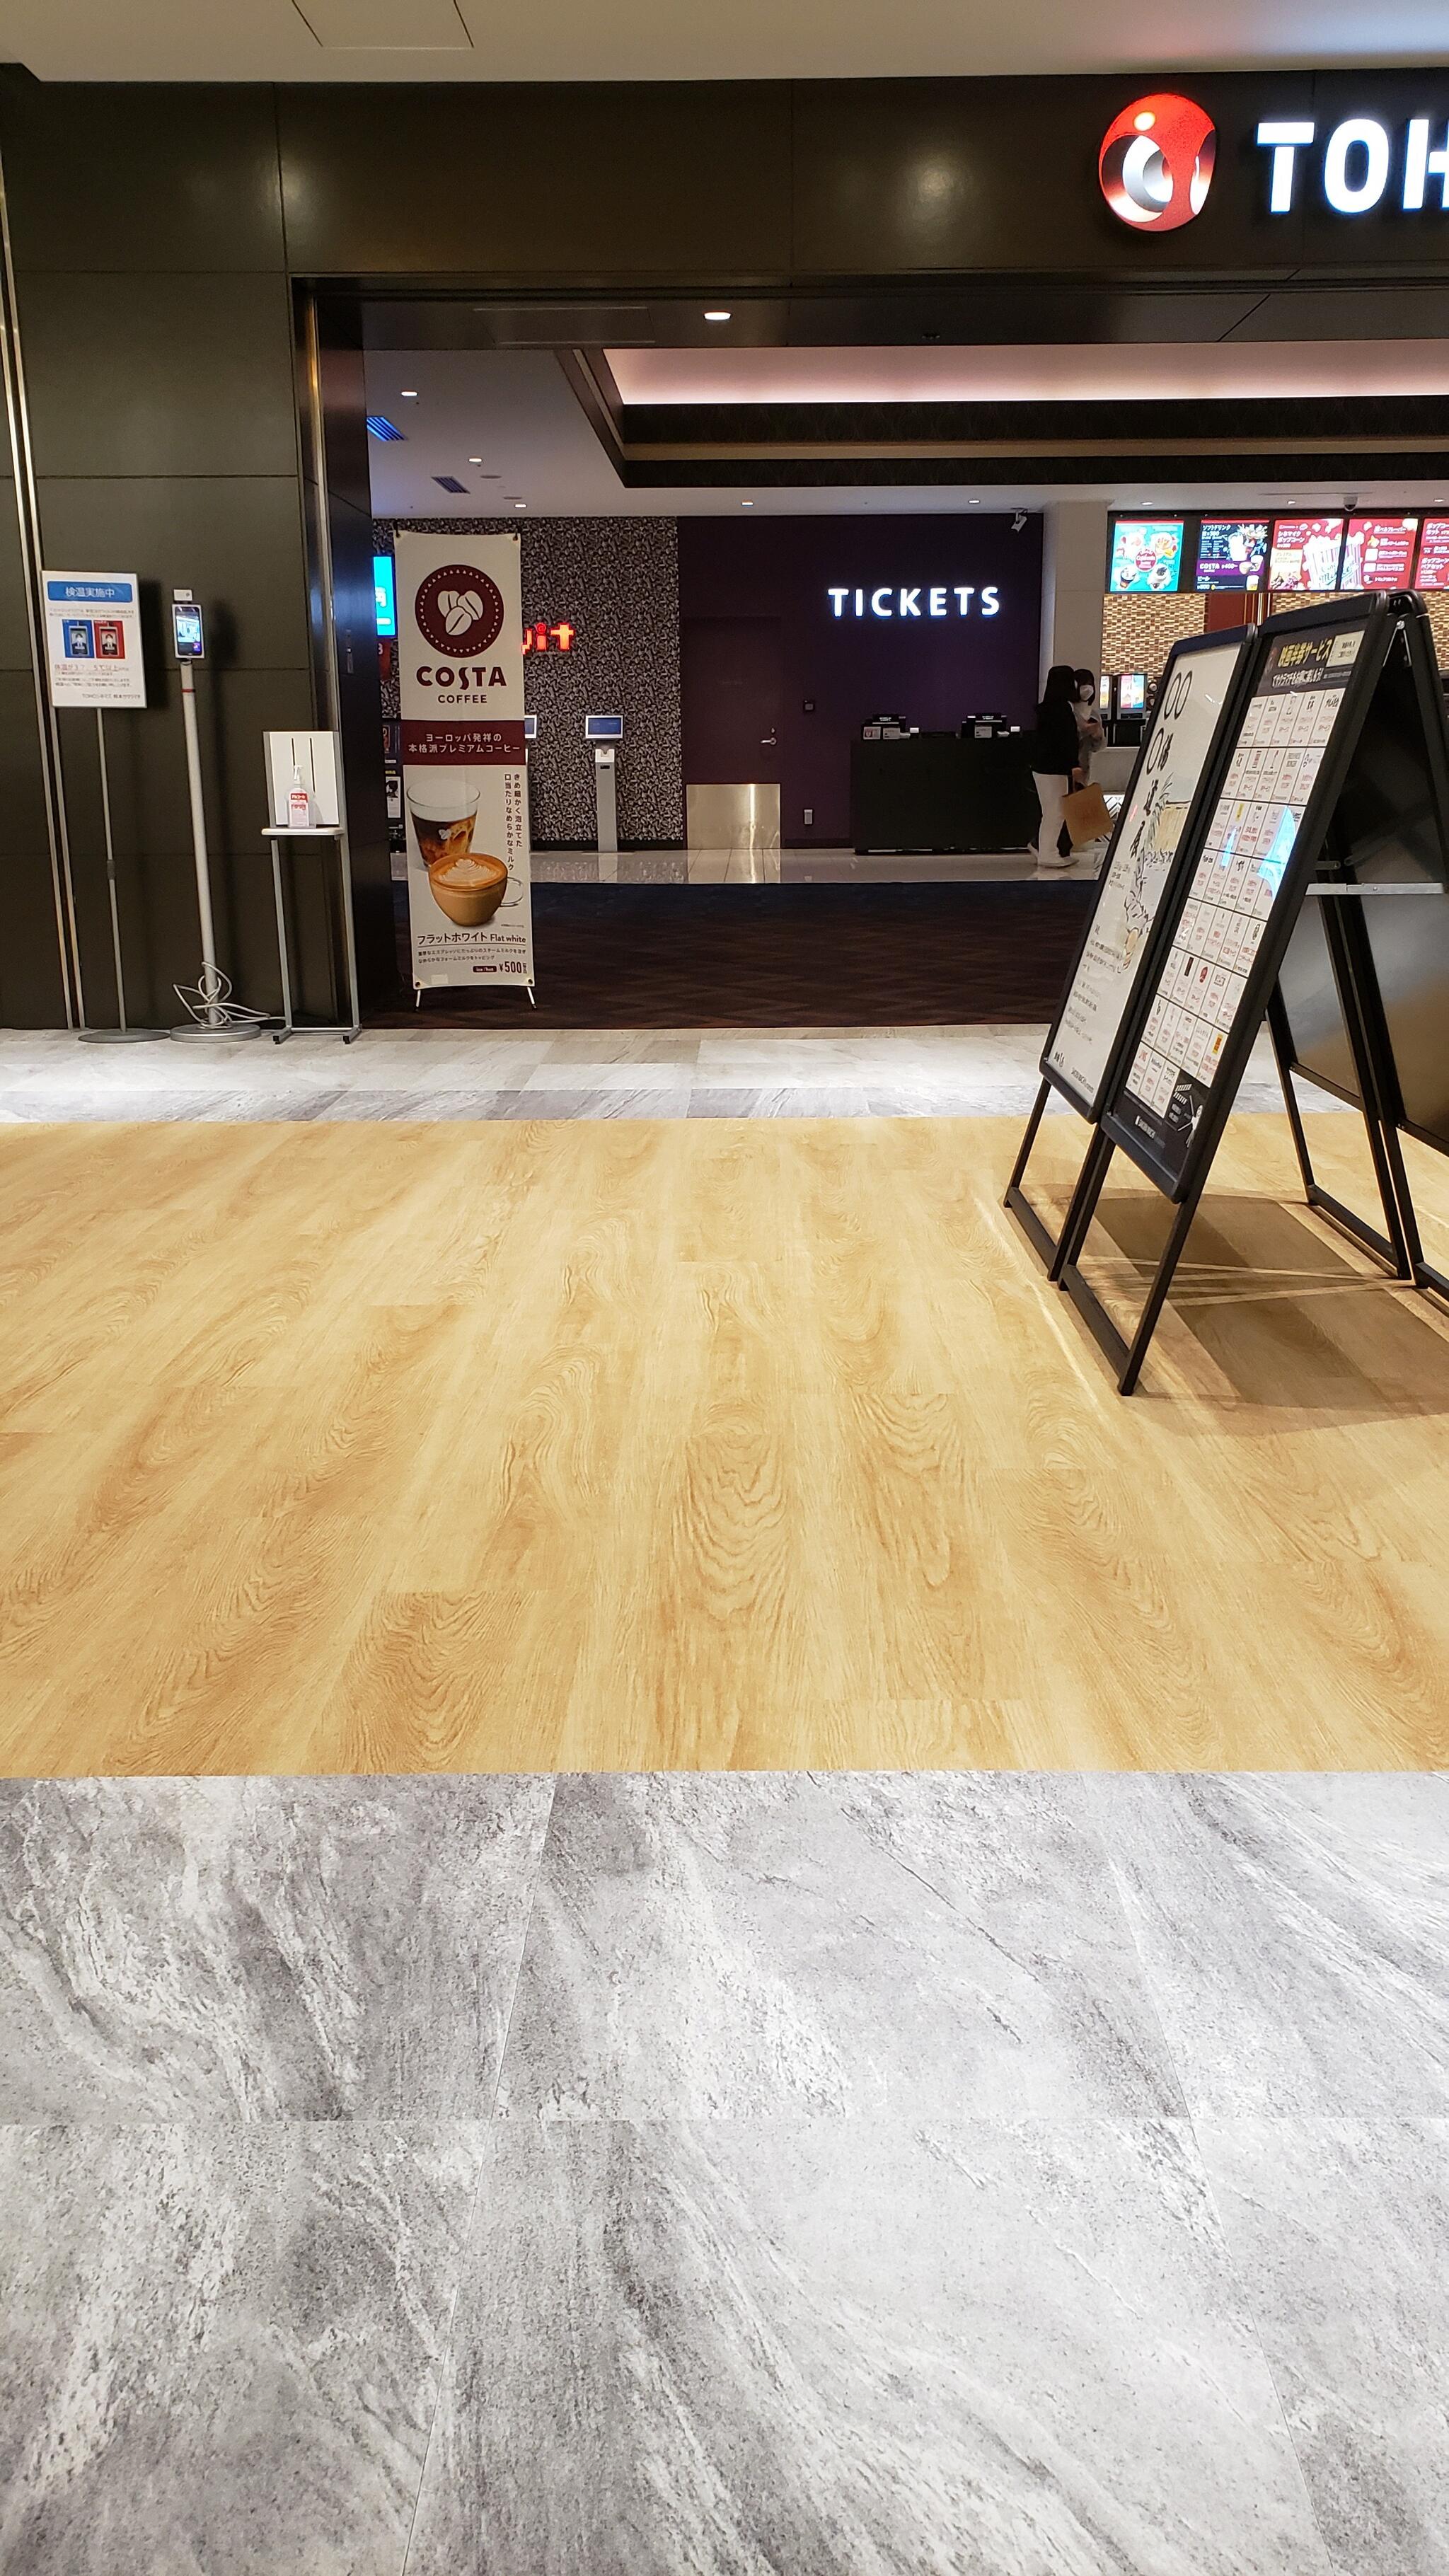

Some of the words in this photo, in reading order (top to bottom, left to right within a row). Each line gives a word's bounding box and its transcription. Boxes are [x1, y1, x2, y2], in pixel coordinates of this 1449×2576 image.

[65, 587, 115, 598] 検温実施中
[828, 587, 1000, 617] TICKETS
[1277, 638, 1333, 668] 映画半券サービス
[416, 666, 507, 691] COSTA
[438, 695, 487, 703] COFFEE
[426, 733, 502, 742] ヨーロッパ発祥の
[408, 744, 521, 753] 本格派プレミアムコーヒー
[514, 773, 523, 847] きめ細かく泡立てた
[504, 773, 514, 870] 口当たりなめらかなミルク
[417, 932, 487, 945] フラットホワイト
[506, 934, 526, 943] white
[499, 961, 522, 974] ¥500
